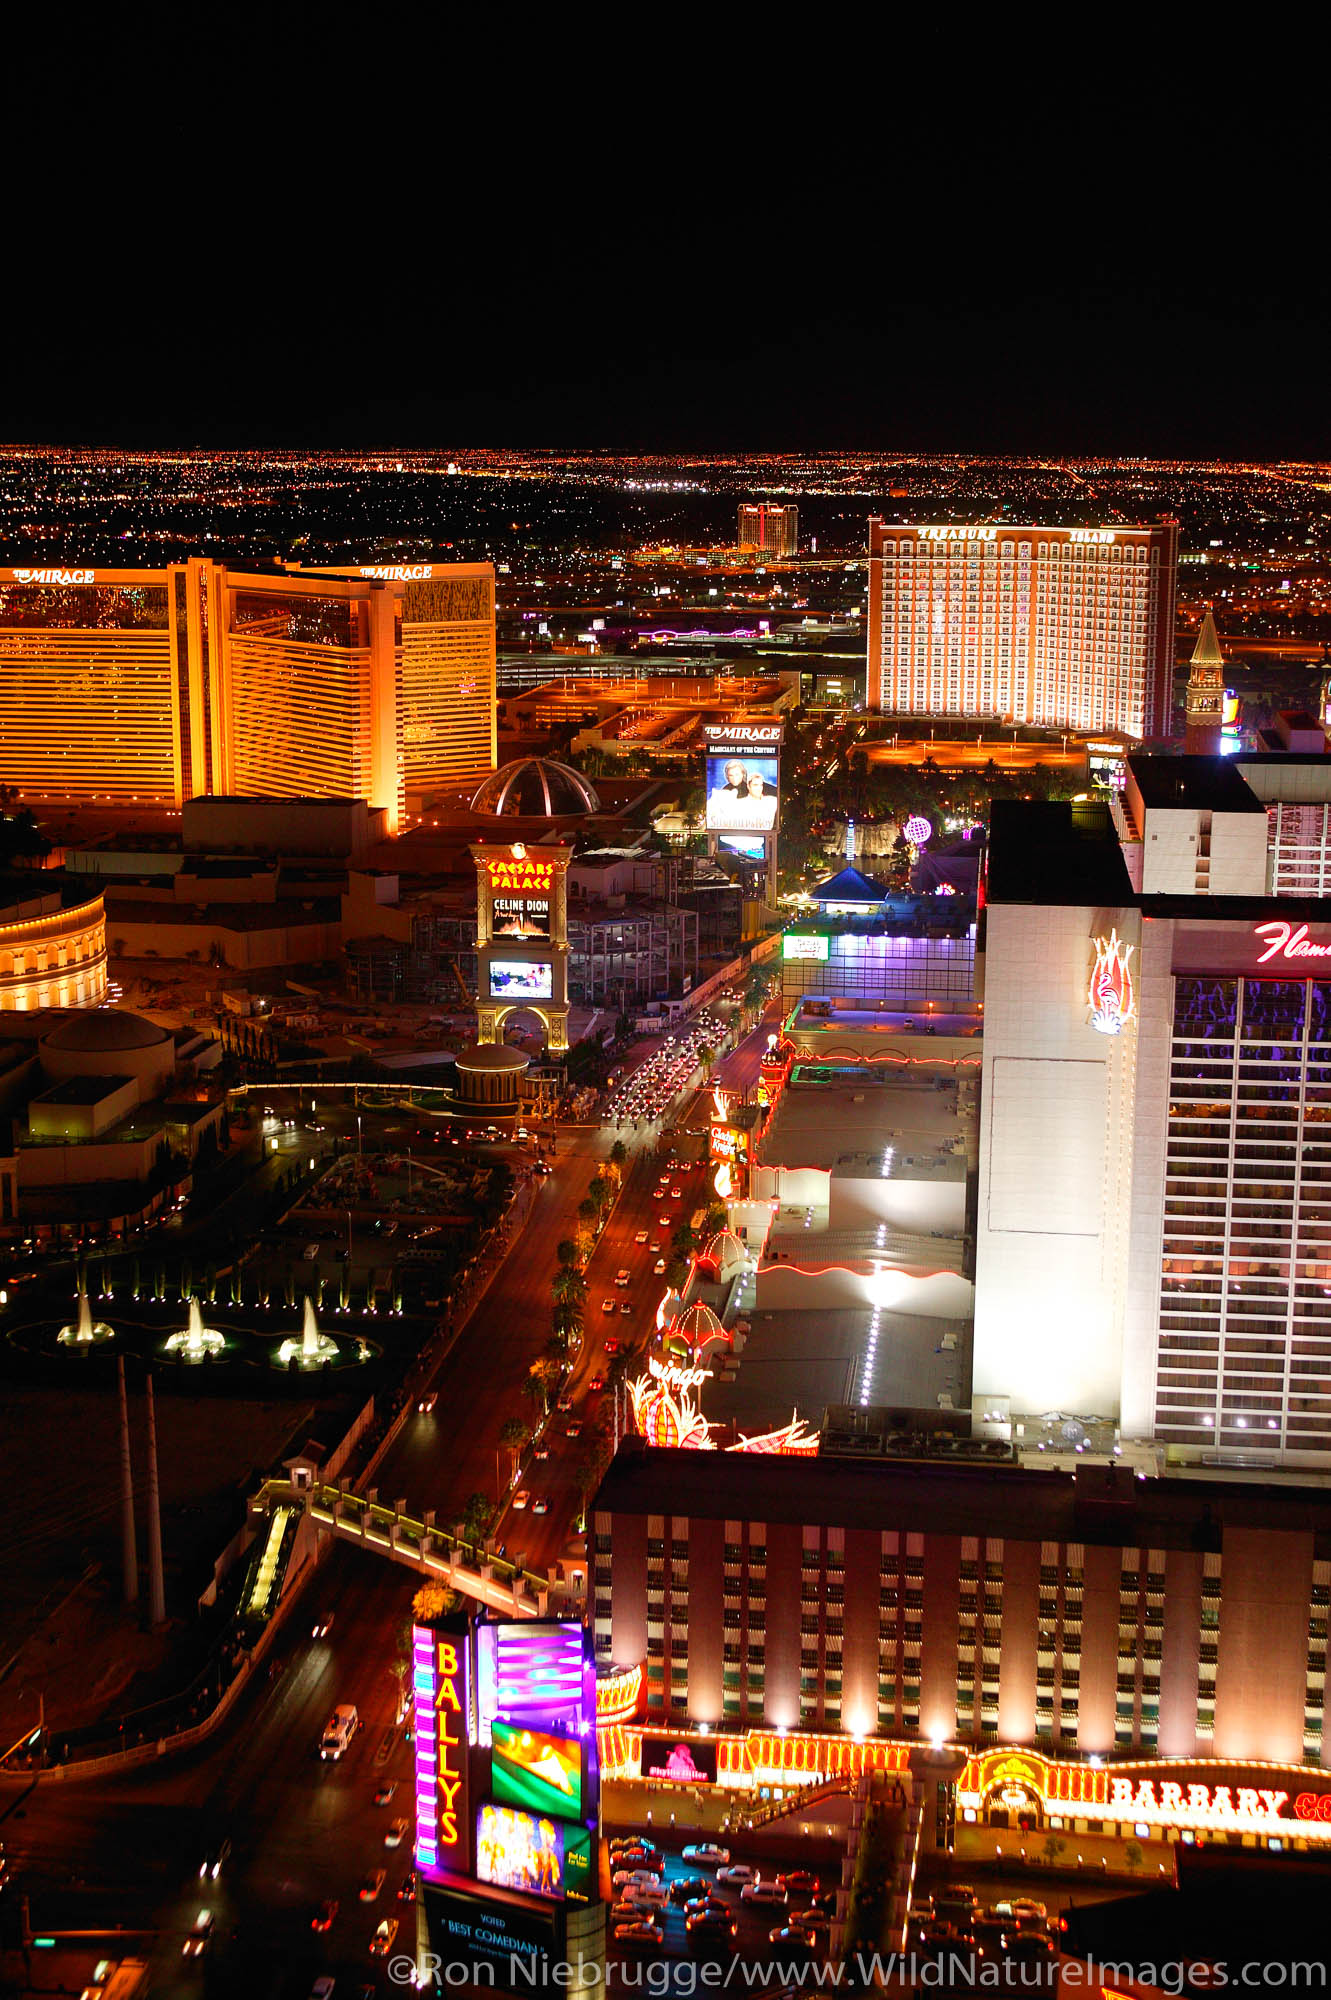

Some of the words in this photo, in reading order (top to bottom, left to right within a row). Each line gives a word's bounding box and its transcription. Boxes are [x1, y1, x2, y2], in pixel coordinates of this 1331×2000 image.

[917, 528, 998, 541] TREASURE
[1069, 530, 1116, 544] ISLAND
[19, 569, 95, 585] MIRAGE
[372, 565, 432, 581] MIRAGE
[711, 727, 780, 741] MIRAGE
[487, 861, 554, 876] CAESARS
[491, 876, 551, 890] PALACE
[494, 899, 524, 910] CELINE
[526, 900, 549, 912] DION
[712, 1138, 736, 1156] Knight
[435, 1642, 462, 1846] BALLYS
[1111, 1777, 1288, 1818] BARBARY
[480, 1913, 506, 1929] VOTED
